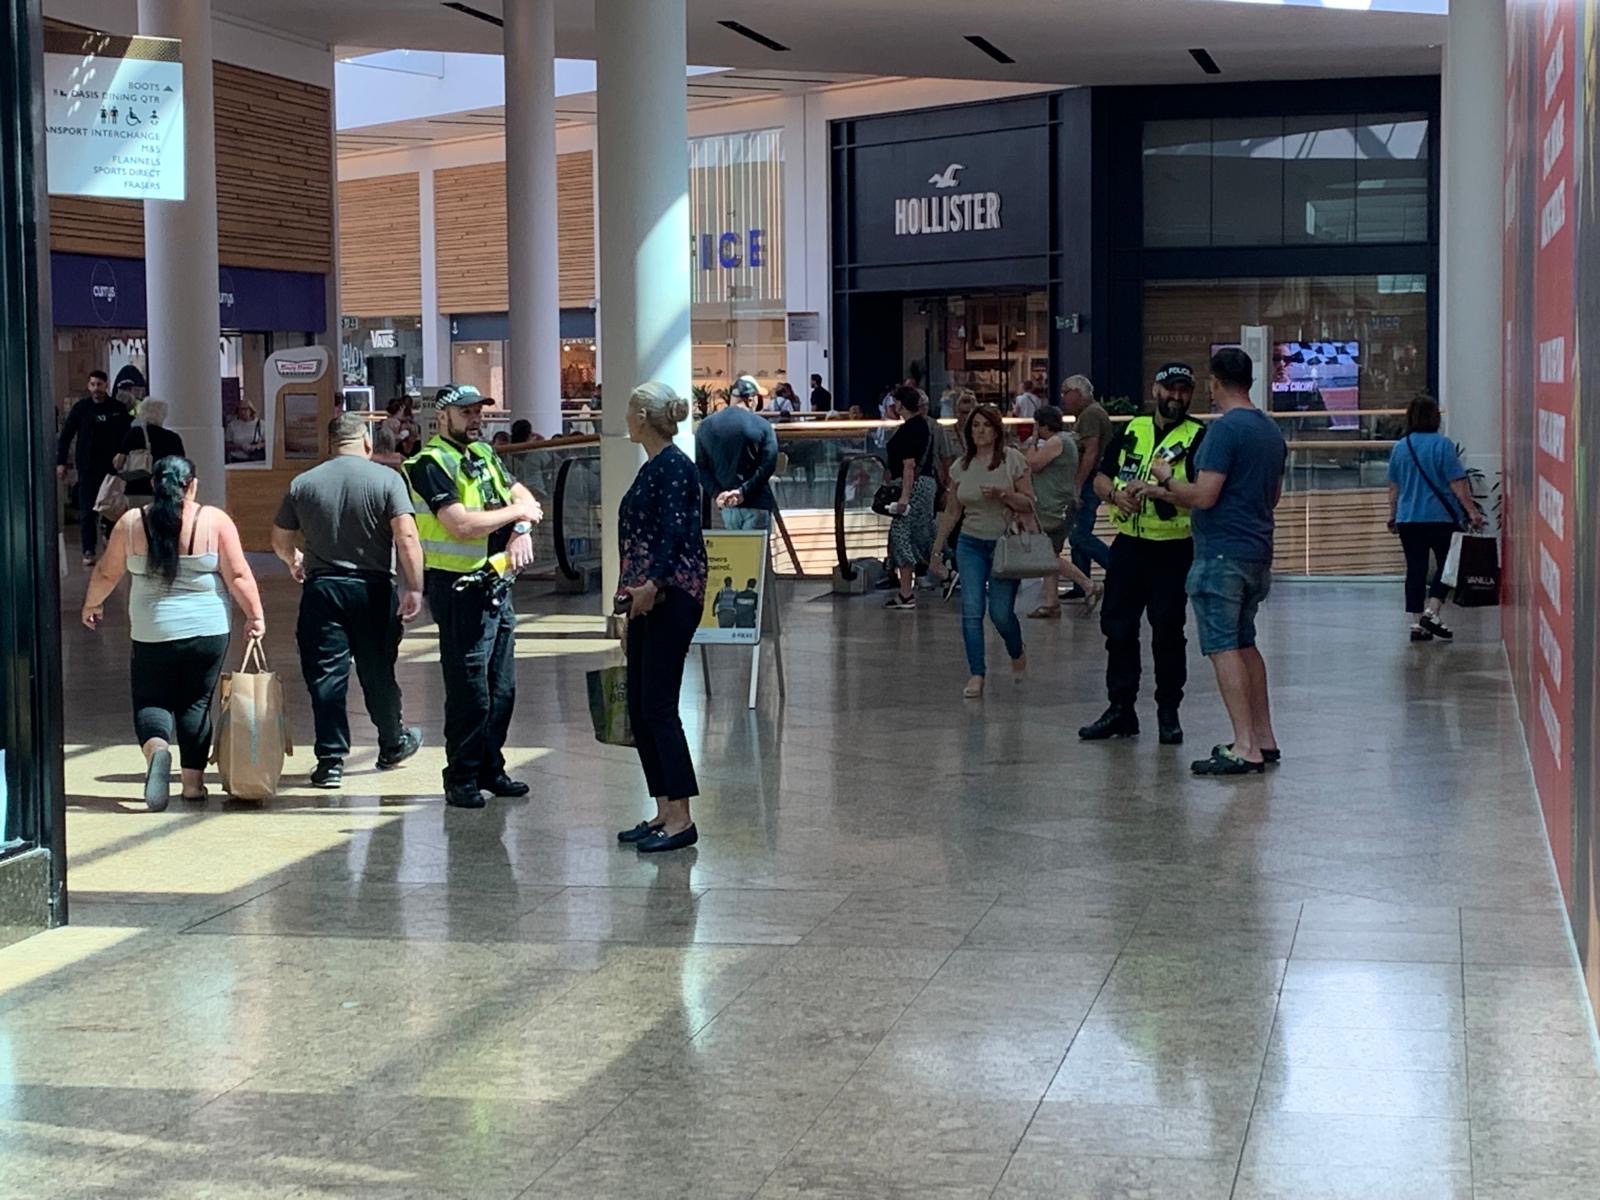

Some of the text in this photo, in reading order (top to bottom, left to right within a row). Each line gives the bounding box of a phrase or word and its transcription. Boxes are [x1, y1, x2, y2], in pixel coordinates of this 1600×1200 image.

[128, 81, 160, 91] BOOTS
[72, 90, 99, 99] OASIS
[140, 95, 160, 103] QTR
[91, 129, 160, 140] INTERCHANGE
[141, 145, 160, 153] M&S
[112, 155, 160, 166] FLANNELS
[93, 166, 160, 177] SPORTS DIRECT
[124, 181, 160, 190] FRASERS
[895, 192, 1001, 235] HOLLISTER
[692, 229, 765, 270] ICE
[370, 330, 396, 348] VANS
